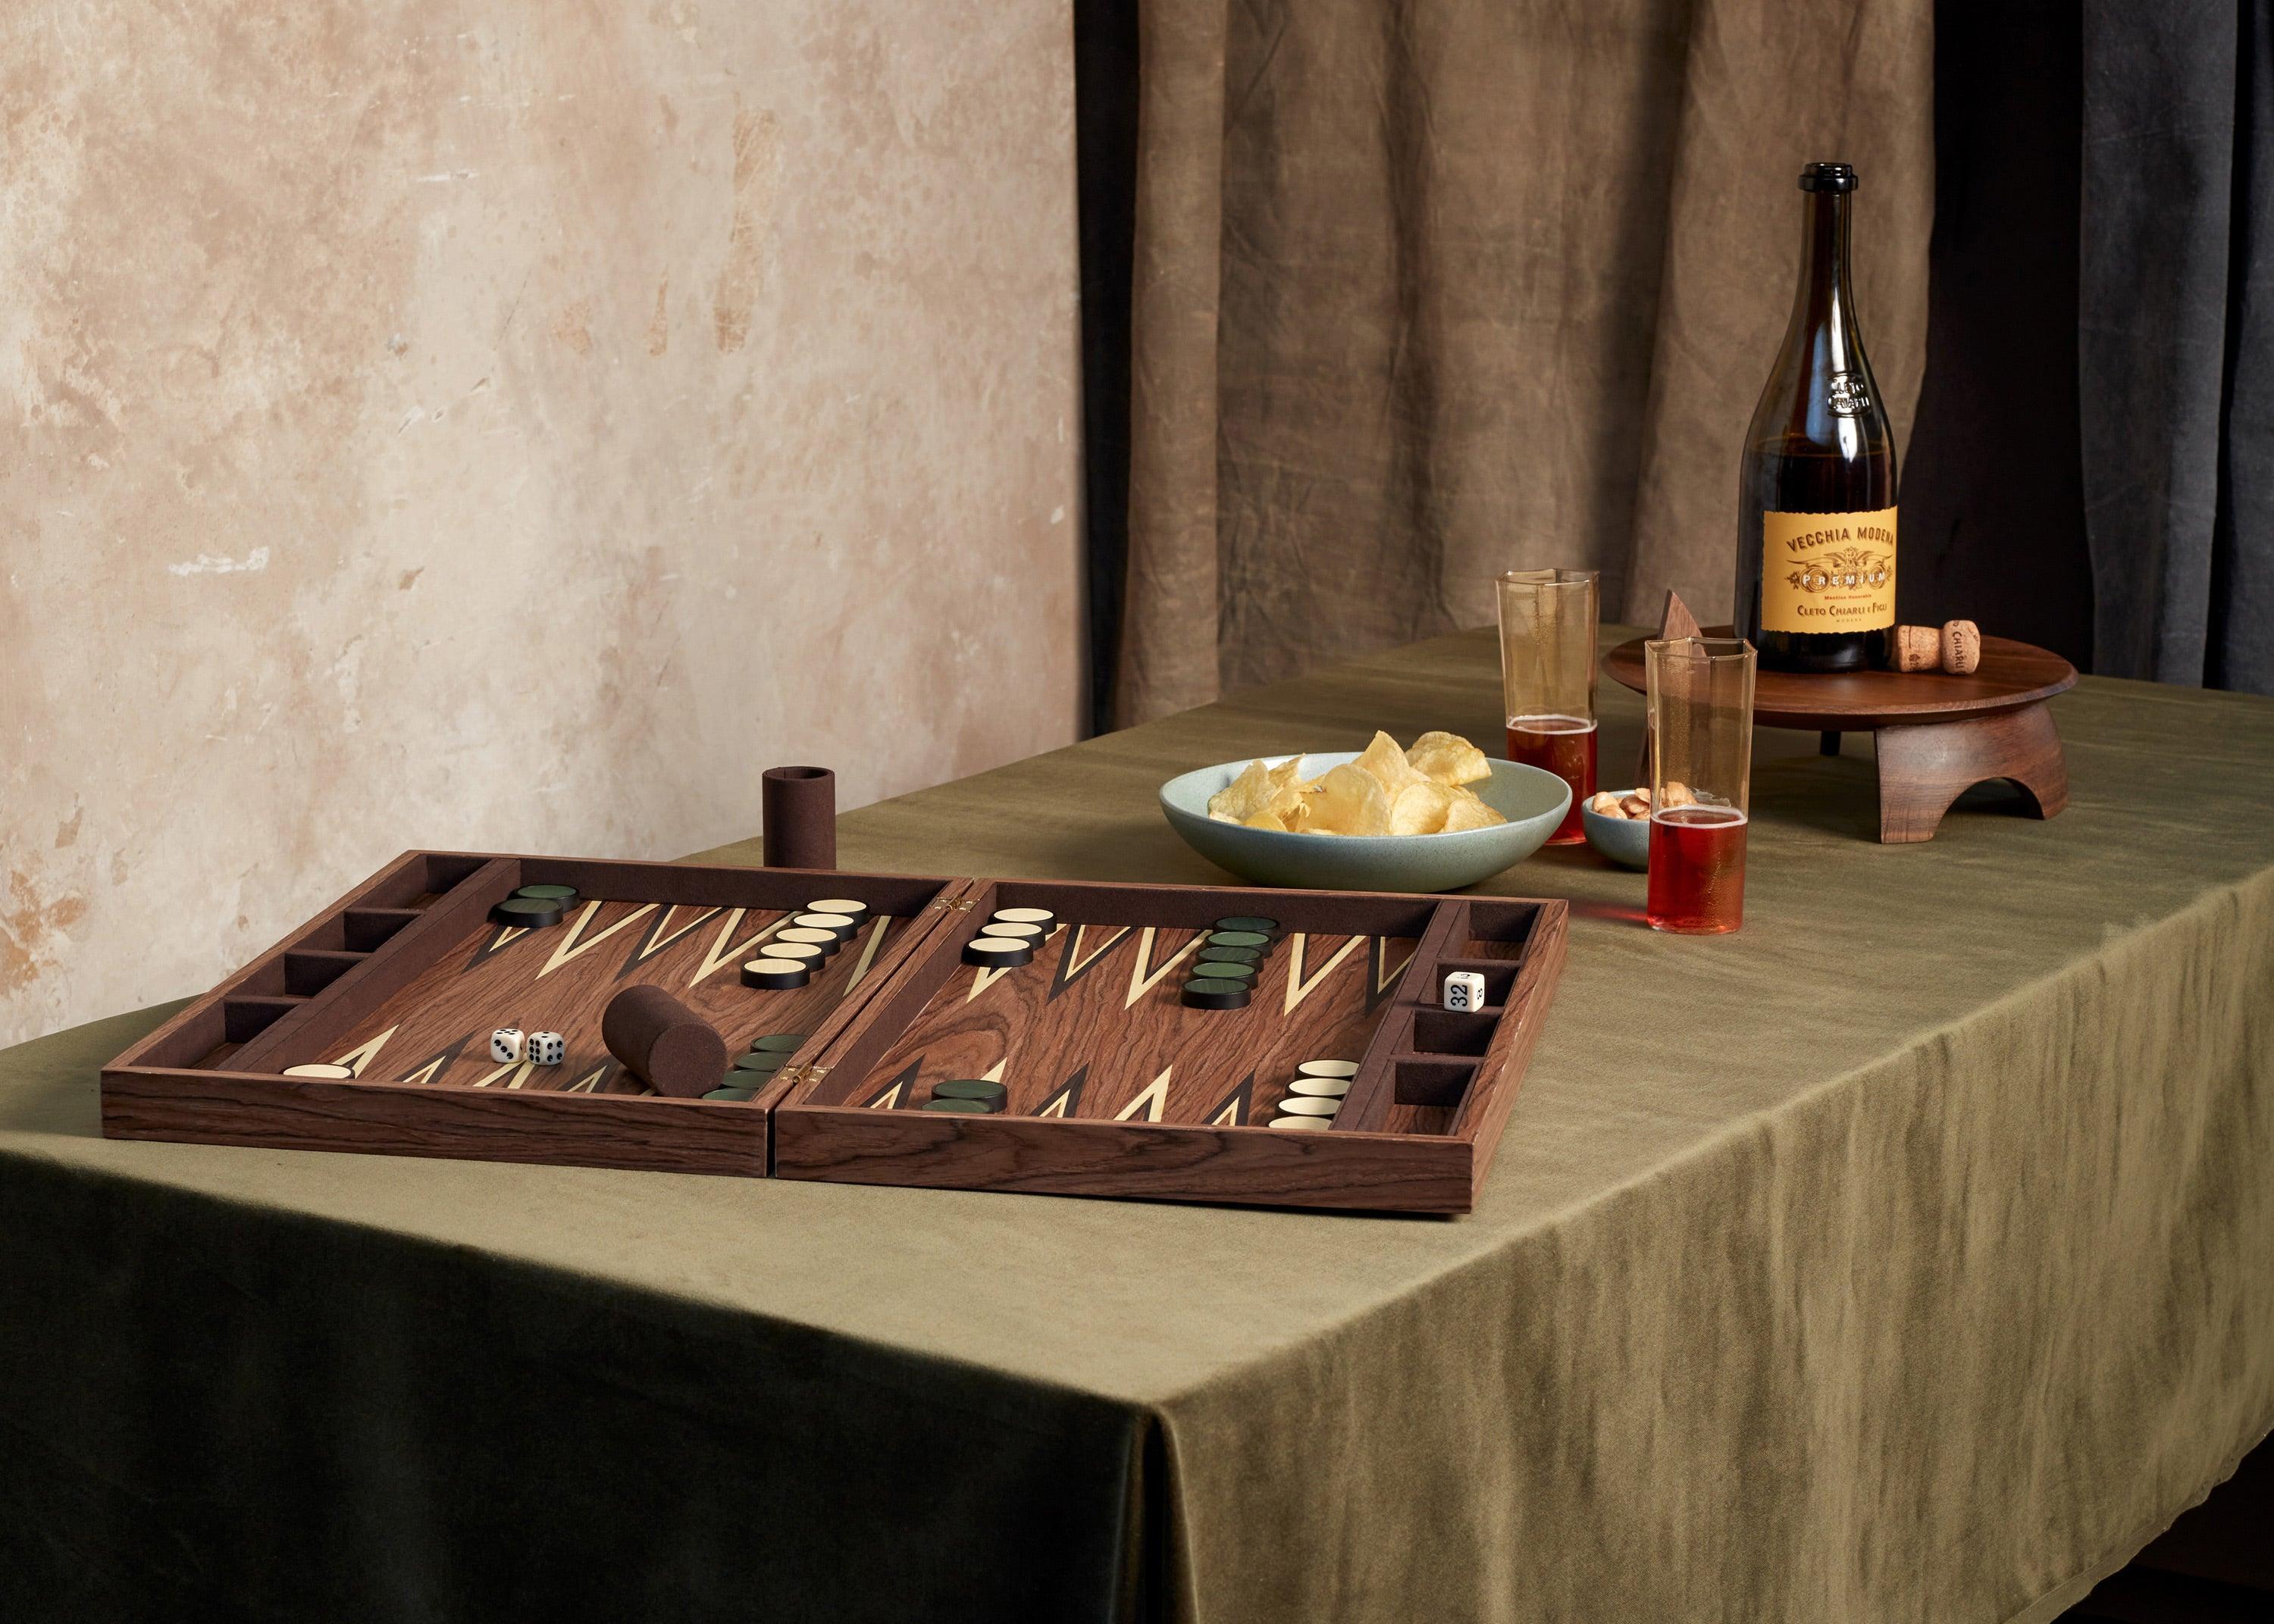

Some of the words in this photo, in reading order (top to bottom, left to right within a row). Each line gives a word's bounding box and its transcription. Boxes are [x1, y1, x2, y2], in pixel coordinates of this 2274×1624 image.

[1787, 527, 1850, 552] VECCHIA
[1857, 527, 1893, 546] MODENA
[1803, 573, 1885, 586] PREMIUM
[1797, 605, 1826, 616] CLETO
[1829, 605, 1865, 616] CHIARLI
[1952, 631, 1964, 668] CHIARLI
[1450, 984, 1467, 1006] 32
